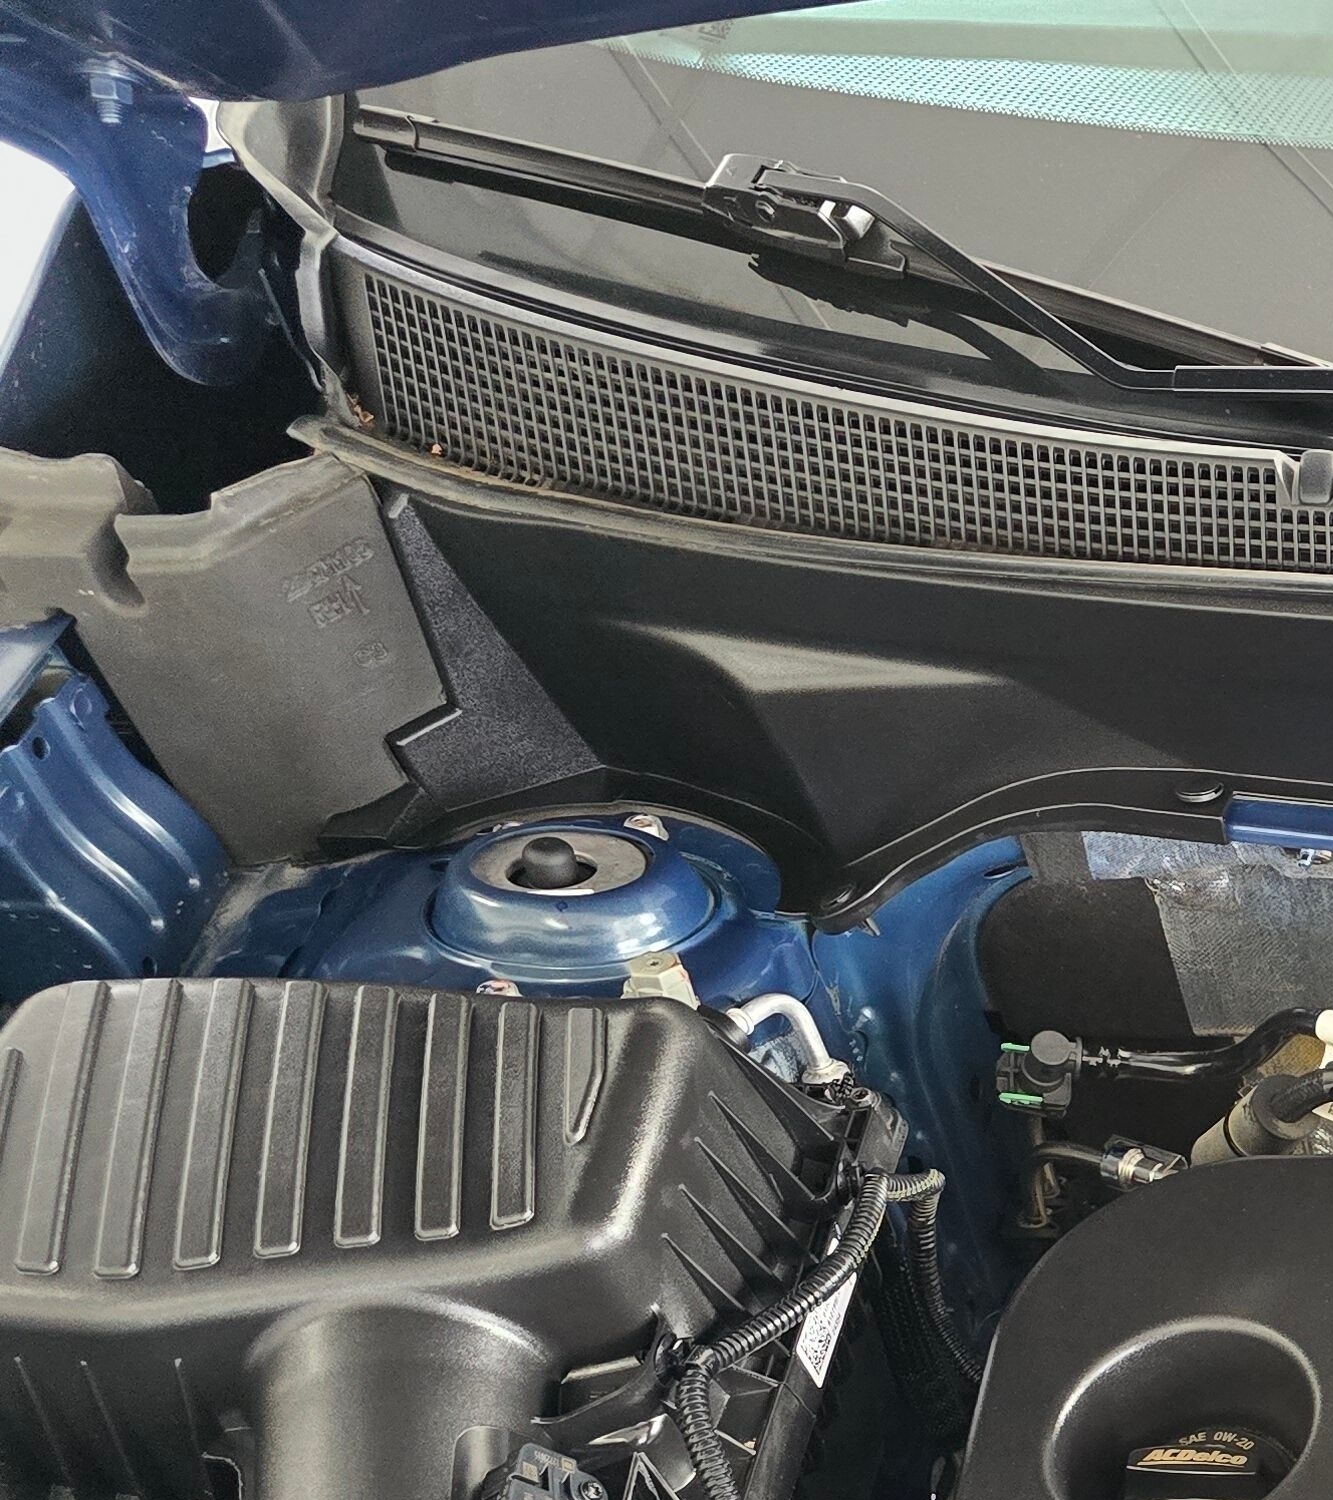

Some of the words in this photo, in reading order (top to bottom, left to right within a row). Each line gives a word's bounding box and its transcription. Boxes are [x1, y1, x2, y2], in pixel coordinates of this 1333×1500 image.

[1179, 1432, 1206, 1446] SAE
[1214, 1430, 1256, 1451] 0W-20
[1143, 1448, 1249, 1466] ACDelco
